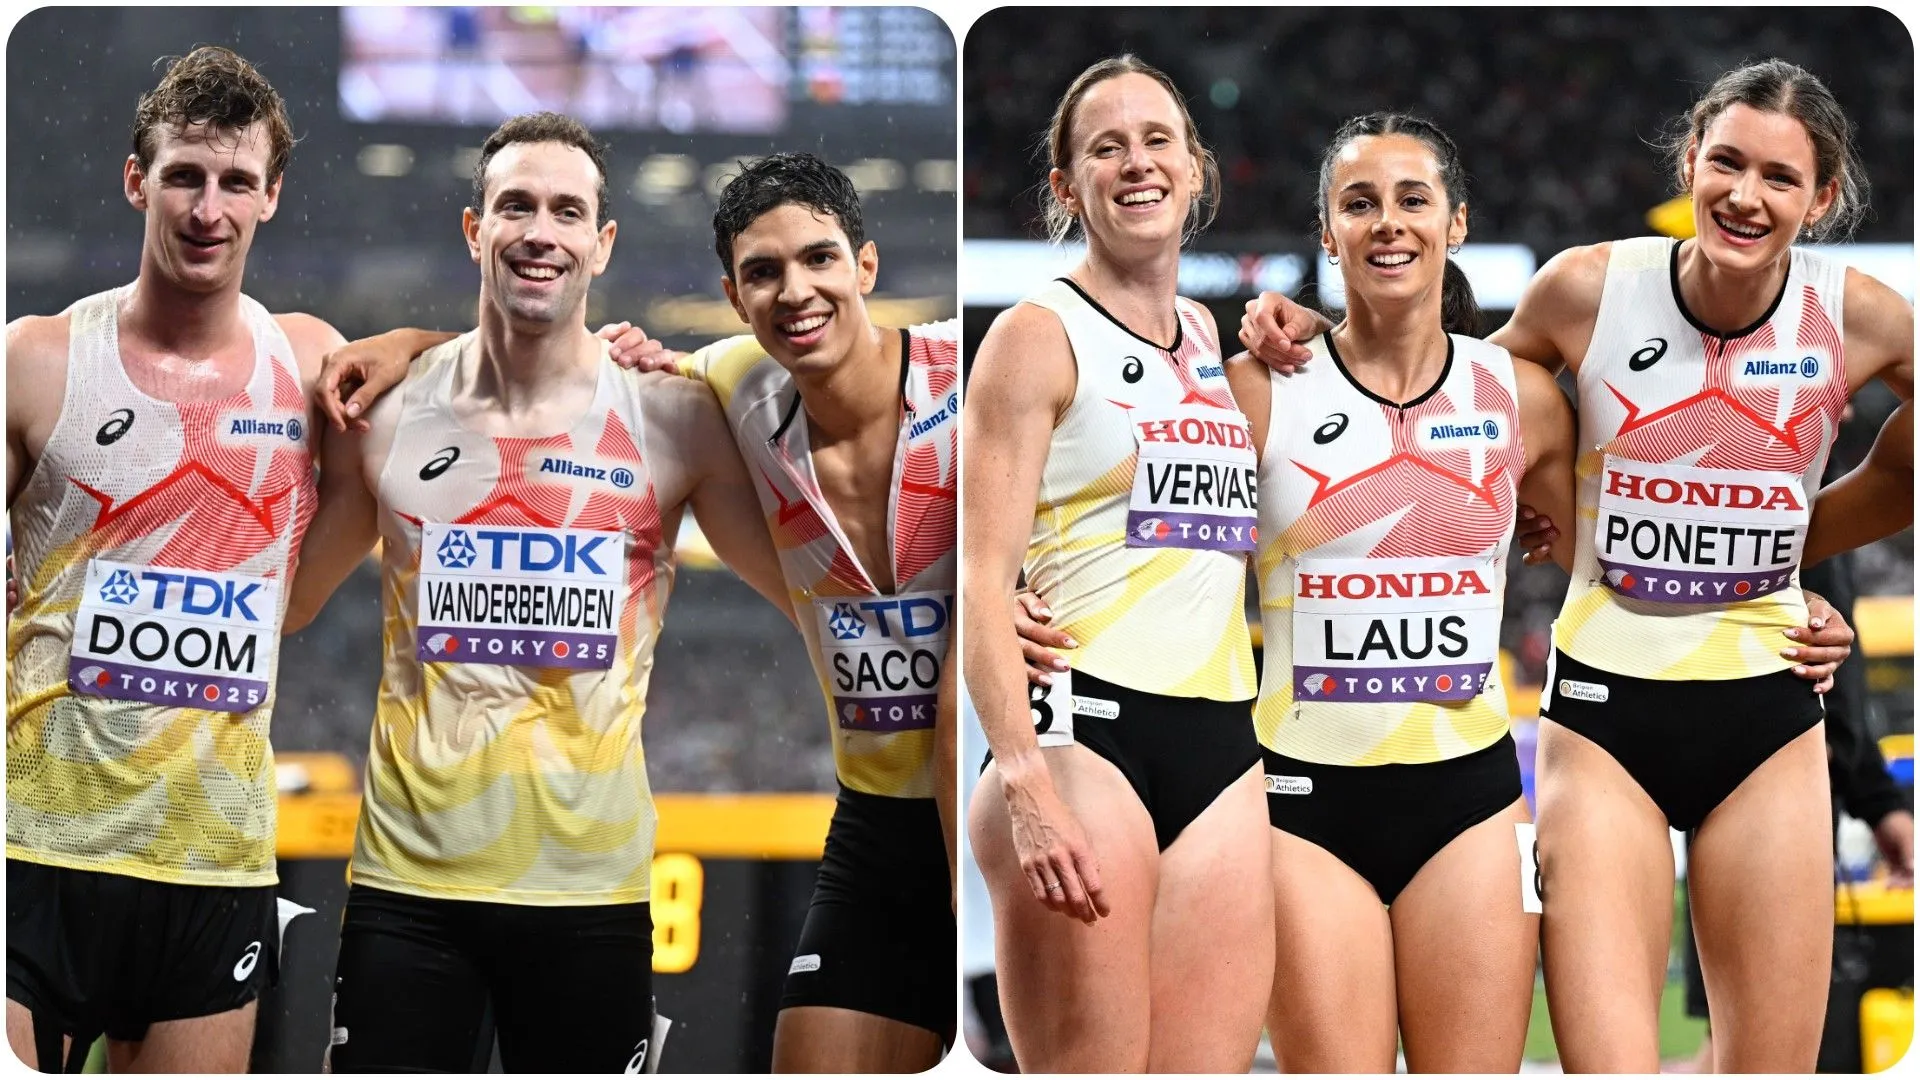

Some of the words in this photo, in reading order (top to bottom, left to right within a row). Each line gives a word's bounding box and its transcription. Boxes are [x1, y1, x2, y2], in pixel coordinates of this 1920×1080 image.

[1744, 361, 1797, 376] Allianz
[230, 419, 284, 436] Allianz
[1430, 424, 1481, 440] Allianz
[540, 458, 606, 480] Allianz
[1606, 470, 1804, 511] HONDA
[477, 531, 608, 575] TDK
[1605, 514, 1796, 566] PONETTE
[142, 572, 262, 622] TDK
[1297, 570, 1490, 599] HONDA
[427, 581, 614, 629] VANDERBEMDEN
[88, 614, 257, 673] DOOM
[1324, 615, 1468, 661] LAUS
[833, 649, 940, 692] SACO
[1078, 705, 1117, 717] Athletics
[1572, 690, 1607, 700] Athletics
[1275, 784, 1311, 792] Athletics
